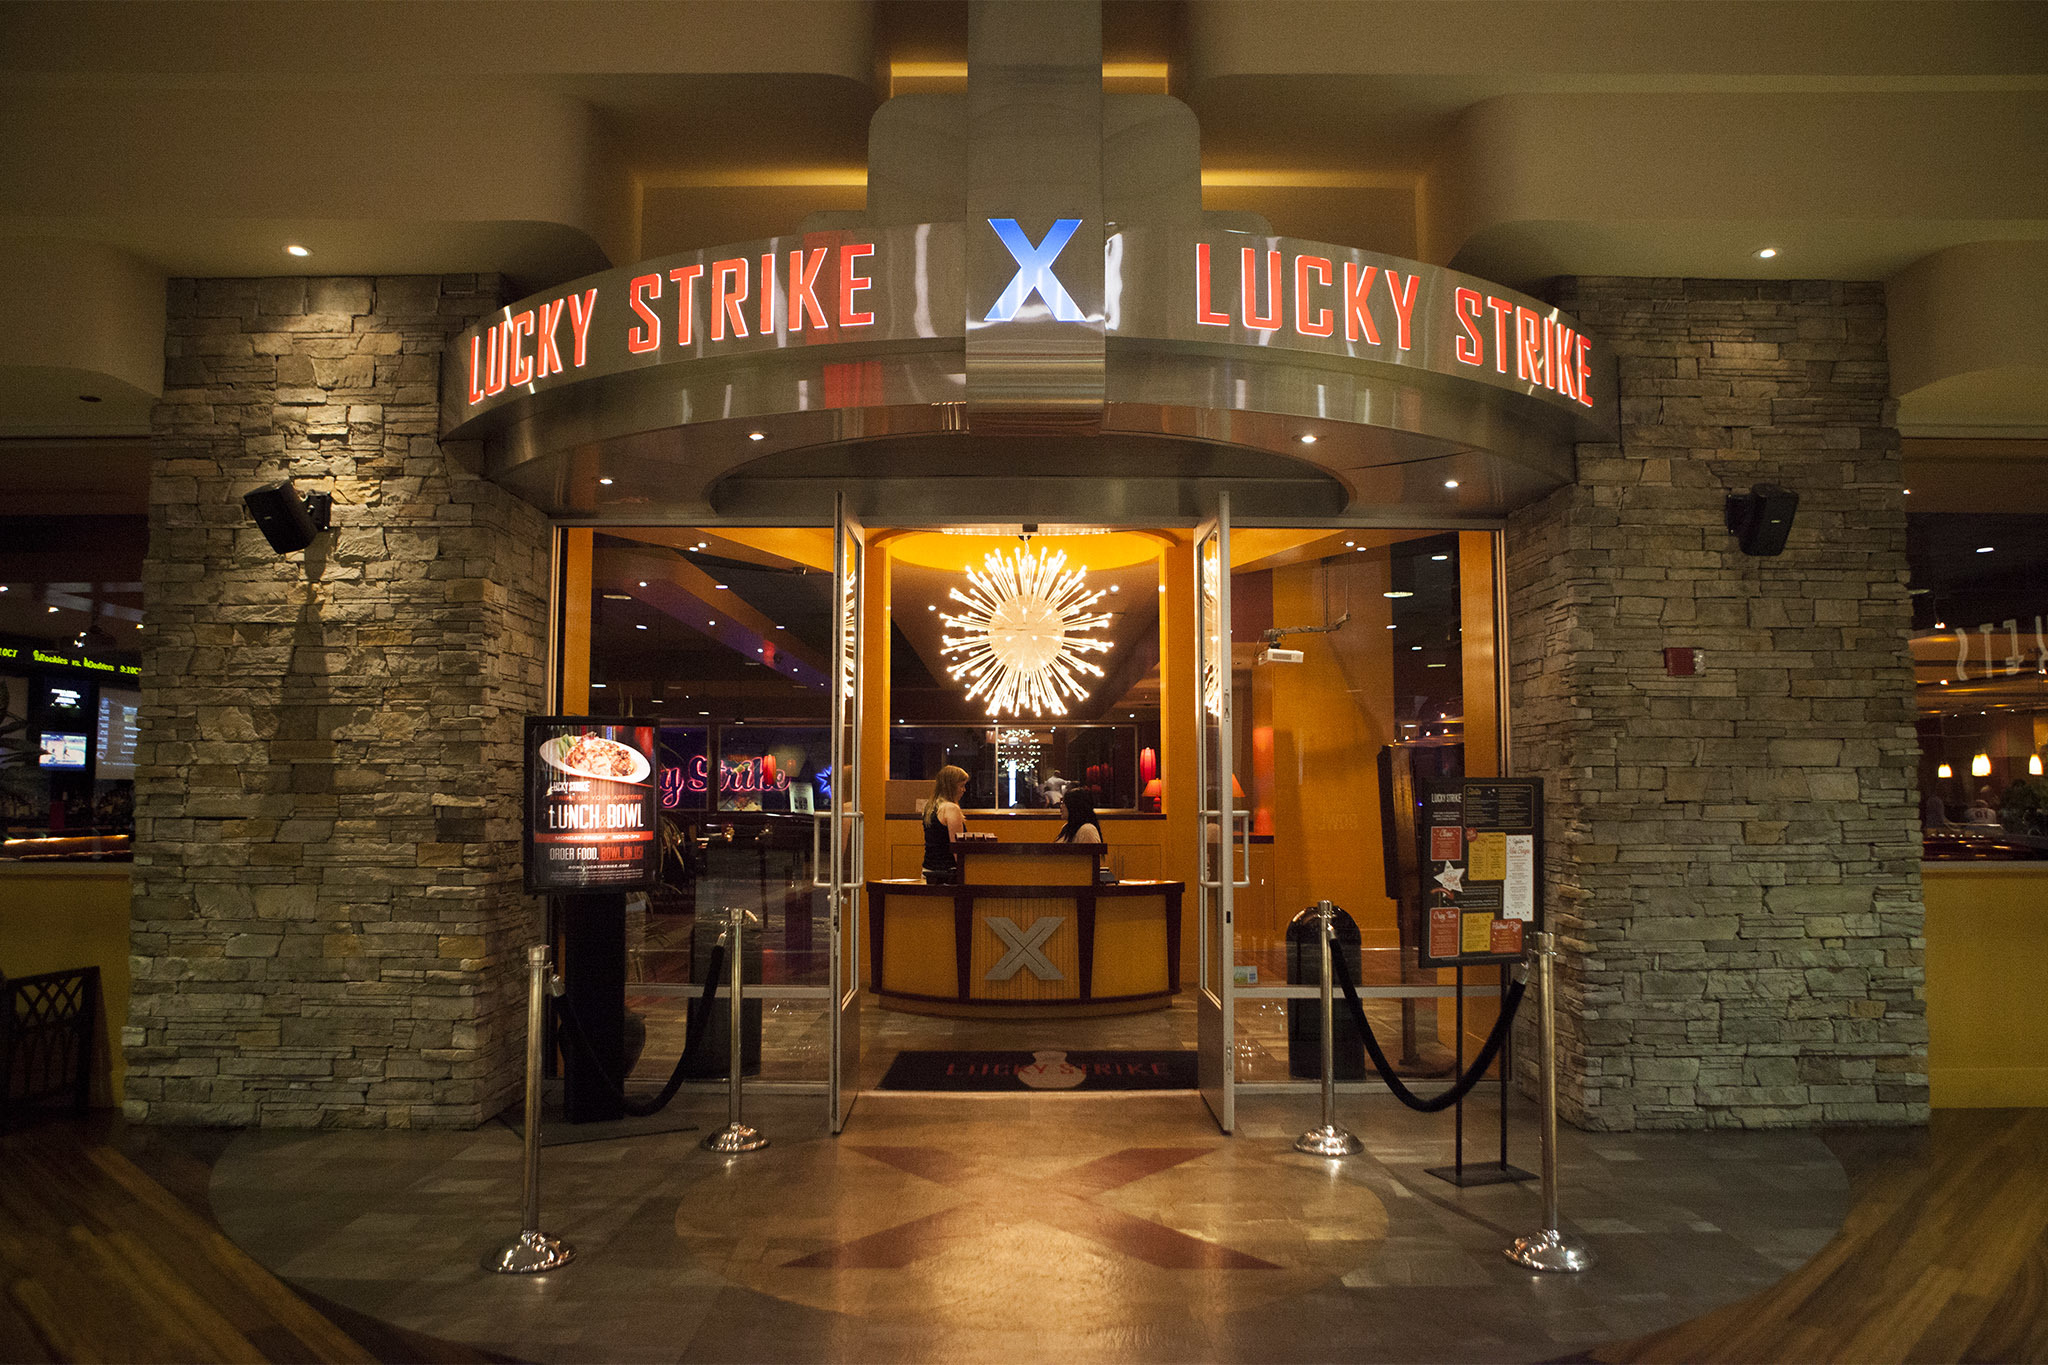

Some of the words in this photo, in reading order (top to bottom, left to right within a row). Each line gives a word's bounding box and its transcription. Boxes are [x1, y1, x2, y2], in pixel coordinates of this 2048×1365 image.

[983, 217, 1088, 323] X
[469, 288, 598, 405] LUCKY
[628, 243, 875, 354] STRIKE
[1195, 242, 1421, 350] LUCKY
[1454, 287, 1594, 408] STRIKE
[549, 803, 600, 829] LUNCH
[607, 803, 644, 829] BOWL
[549, 847, 575, 861] ORDER
[576, 846, 599, 861] FOOD.
[600, 846, 621, 861] BOWL
[983, 916, 1067, 981] X
[946, 1063, 1048, 1076] LUCKY
[1059, 1063, 1168, 1076] STRIKE
